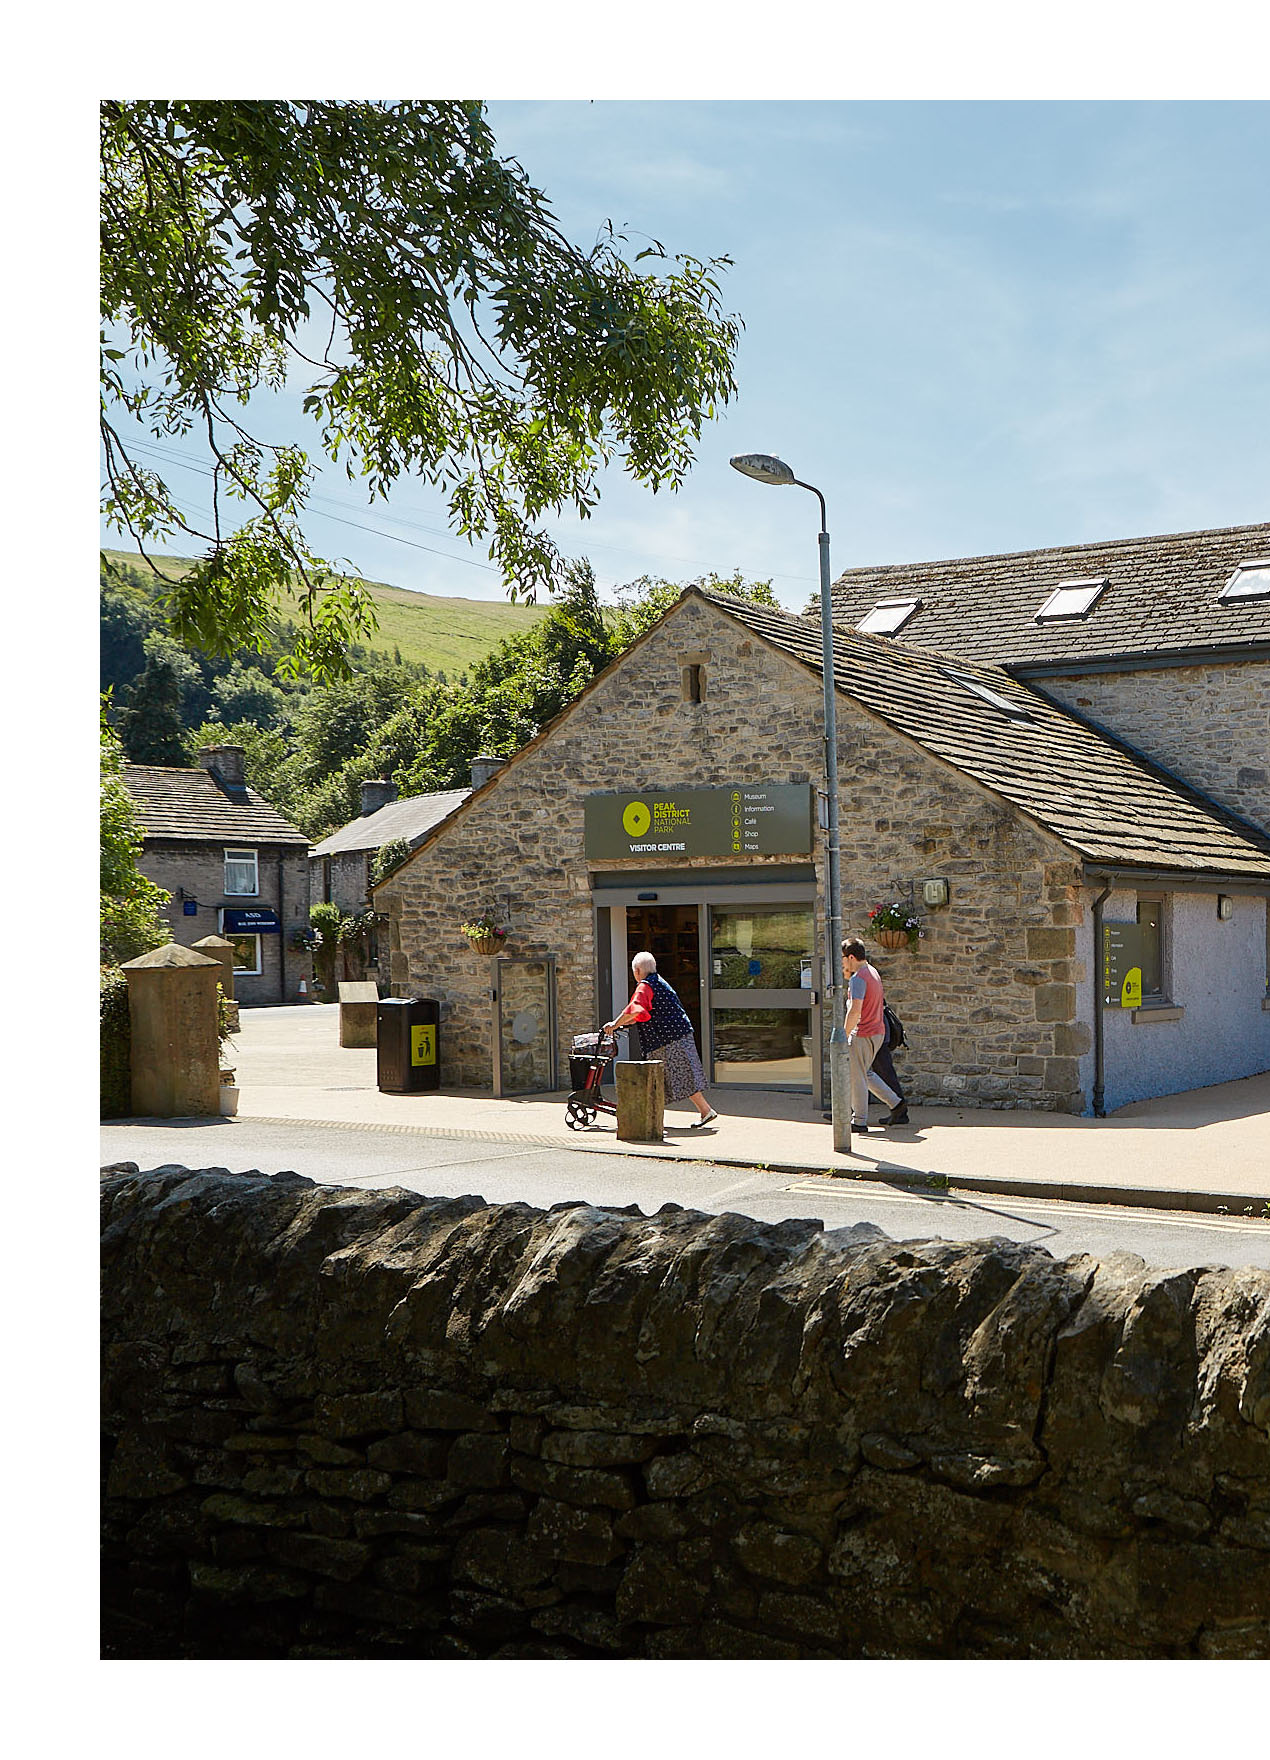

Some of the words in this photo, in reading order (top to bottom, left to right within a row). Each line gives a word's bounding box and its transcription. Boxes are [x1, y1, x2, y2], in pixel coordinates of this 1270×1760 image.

[653, 802, 675, 811] PEAK
[744, 805, 775, 813] Information
[653, 809, 691, 819] DISTRICT
[653, 817, 692, 826] NATIONAL
[653, 825, 674, 833] PARK
[744, 830, 759, 838] Shop
[629, 843, 657, 852] VISITOR
[657, 842, 686, 851] CENTRE
